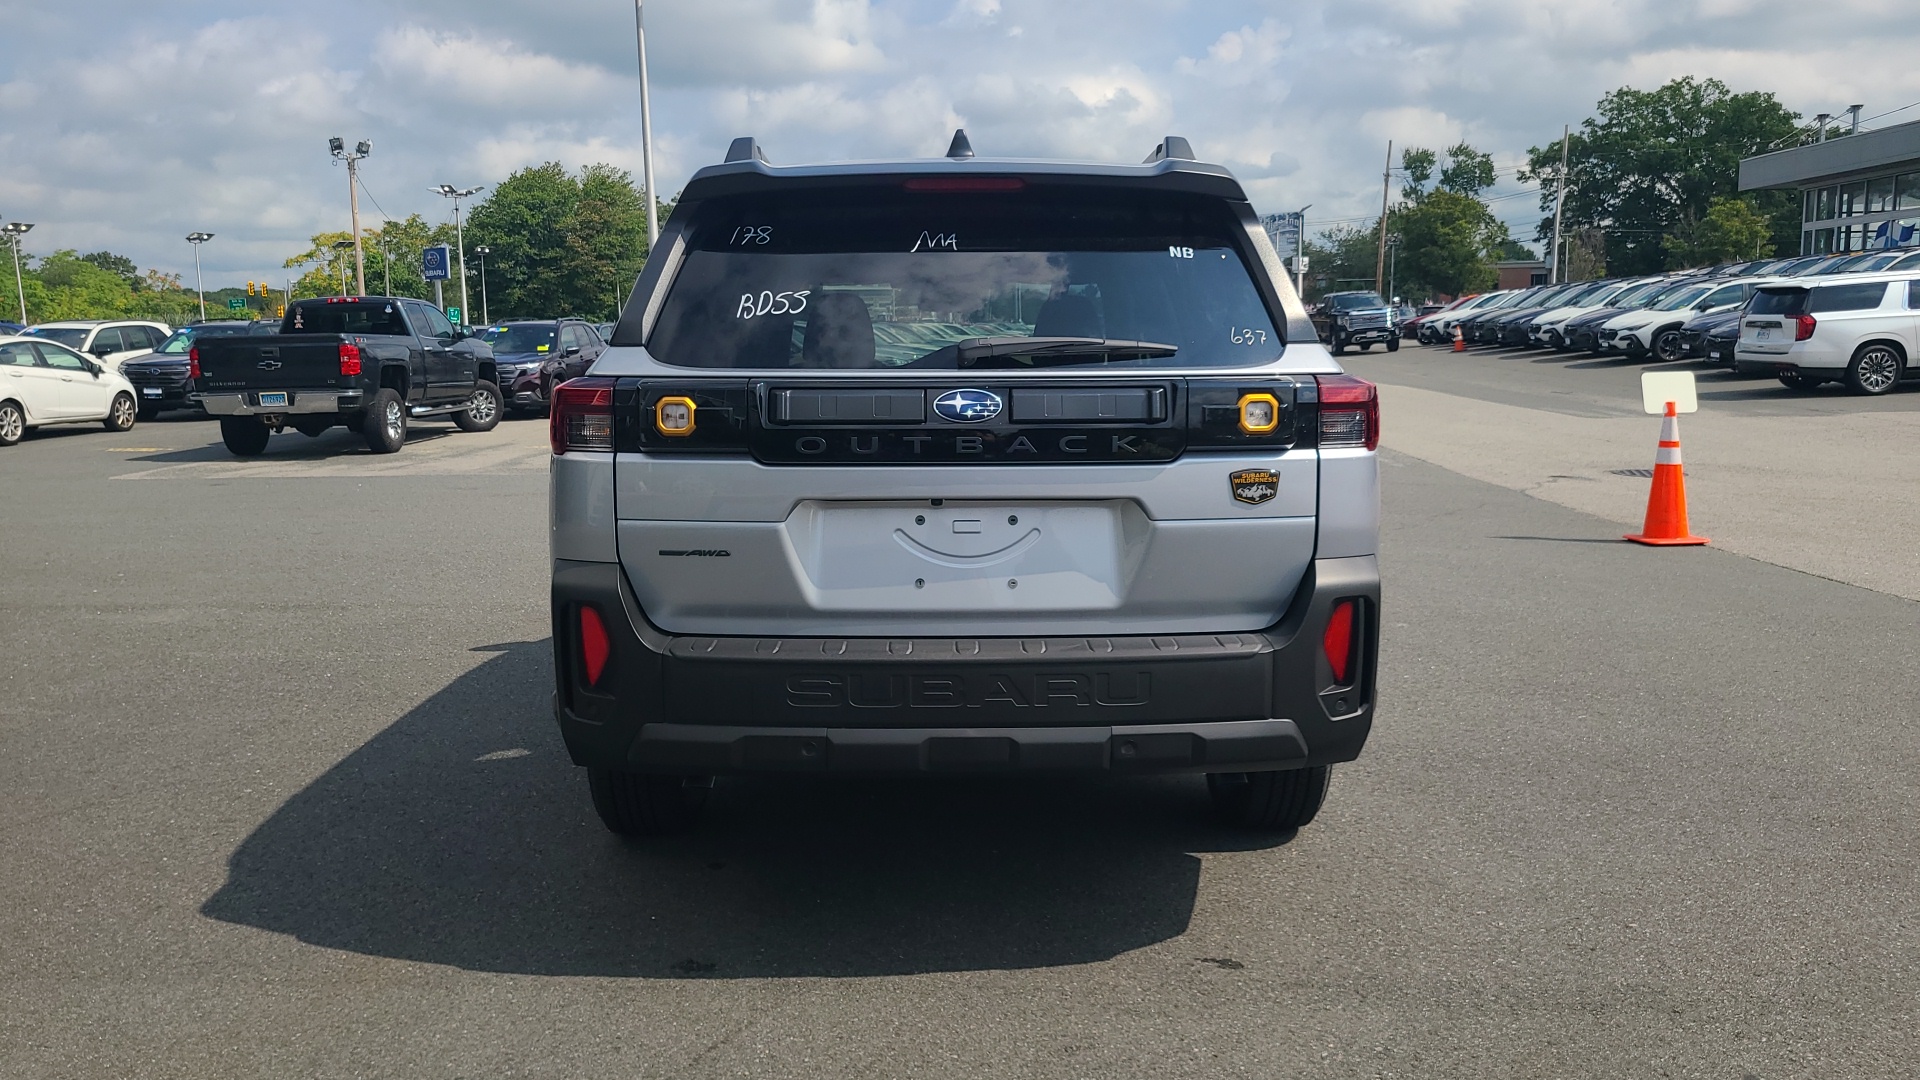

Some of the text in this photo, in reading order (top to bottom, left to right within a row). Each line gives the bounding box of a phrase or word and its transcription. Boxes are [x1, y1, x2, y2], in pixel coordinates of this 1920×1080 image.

[730, 226, 773, 246] 178
[1169, 246, 1194, 259] NB
[1230, 326, 1266, 346] 637
[795, 436, 1138, 454] OUTBACK
[1234, 476, 1277, 484] WILDERNESS
[685, 549, 732, 557] AWD
[785, 672, 1153, 708] SUBARU
